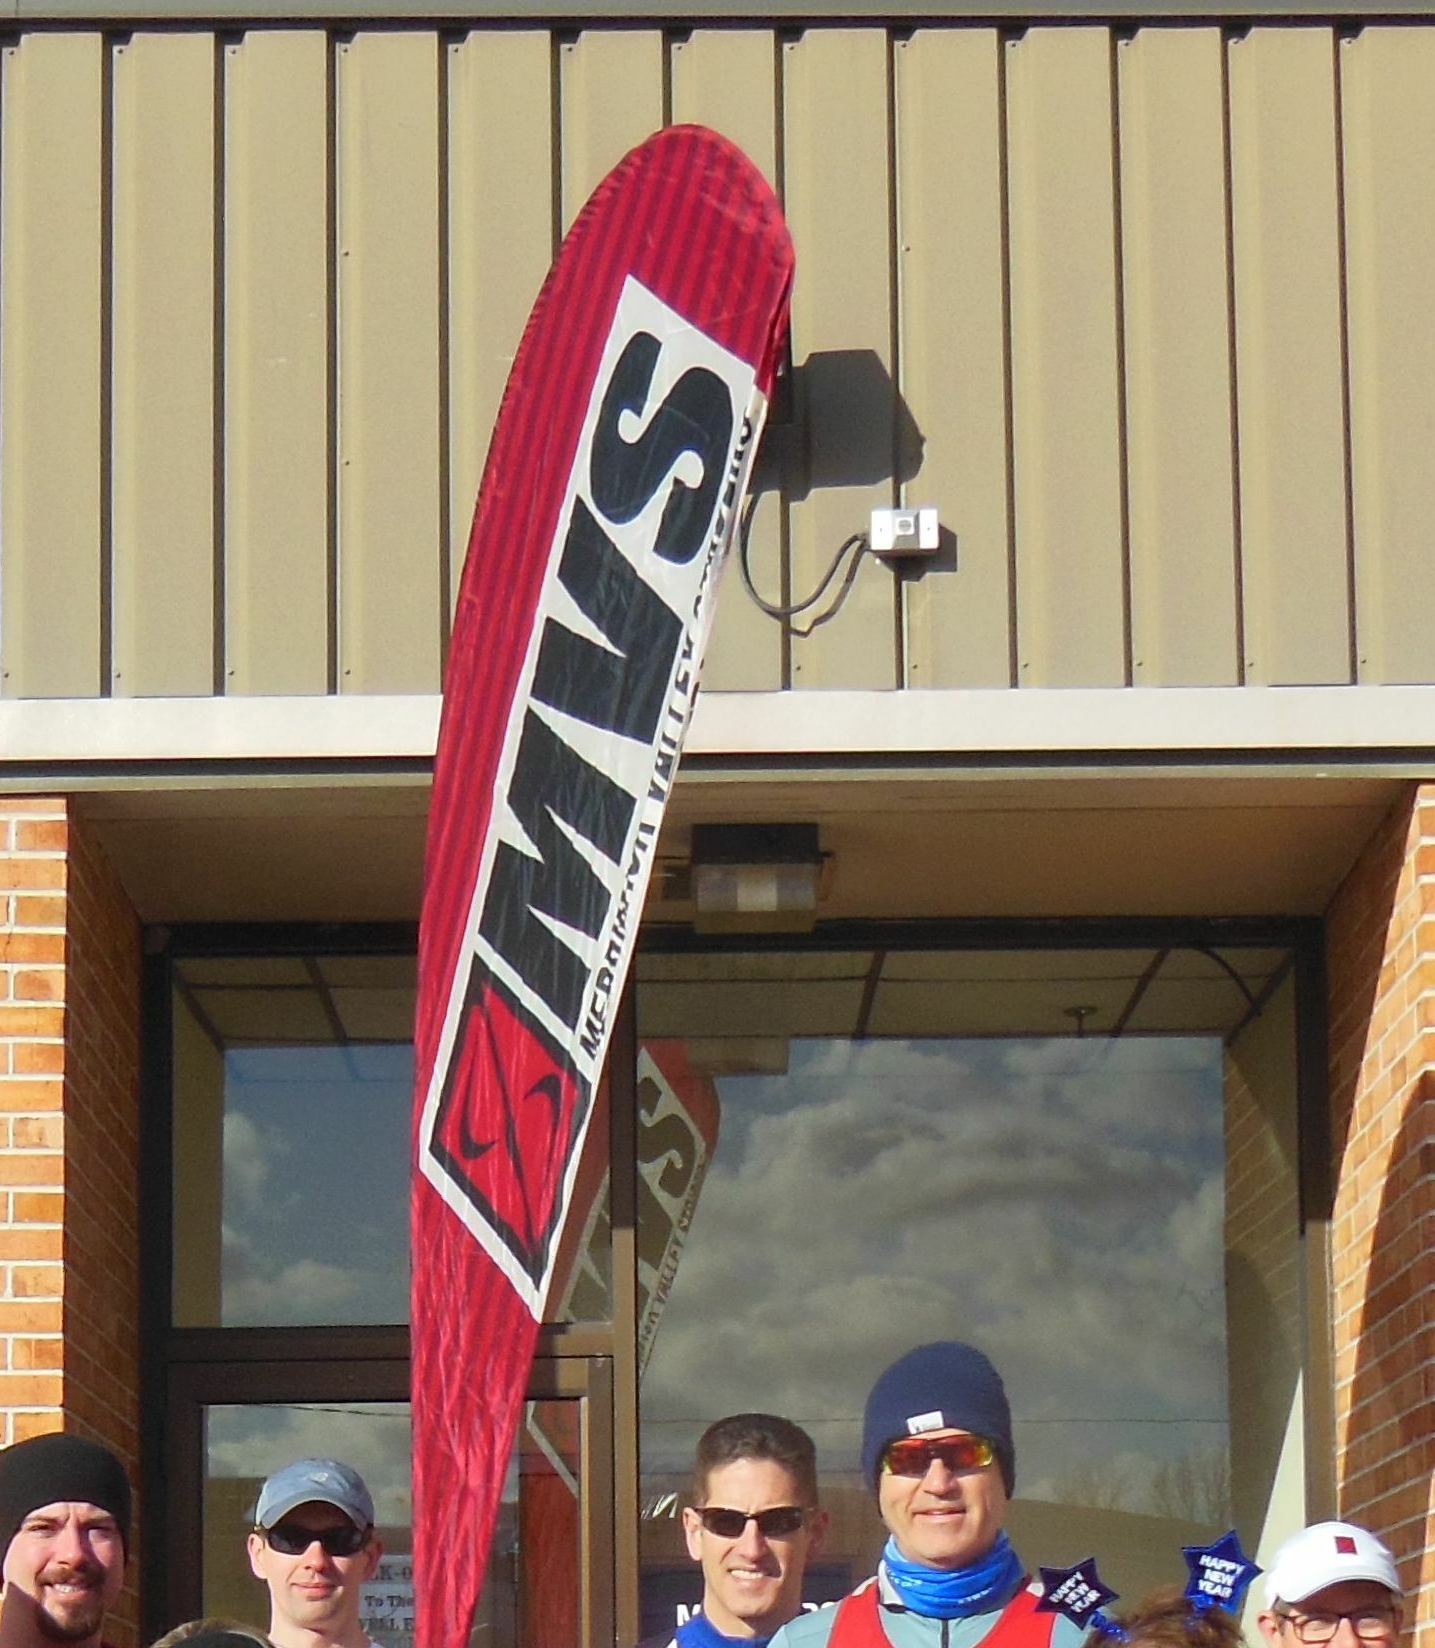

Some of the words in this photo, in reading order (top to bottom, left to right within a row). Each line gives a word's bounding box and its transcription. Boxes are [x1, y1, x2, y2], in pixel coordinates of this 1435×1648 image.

[478, 331, 734, 1034] MVS
[1198, 1554, 1245, 1576] HAPPY
[1204, 1569, 1236, 1586] NEW
[1198, 1579, 1233, 1598] YEAR
